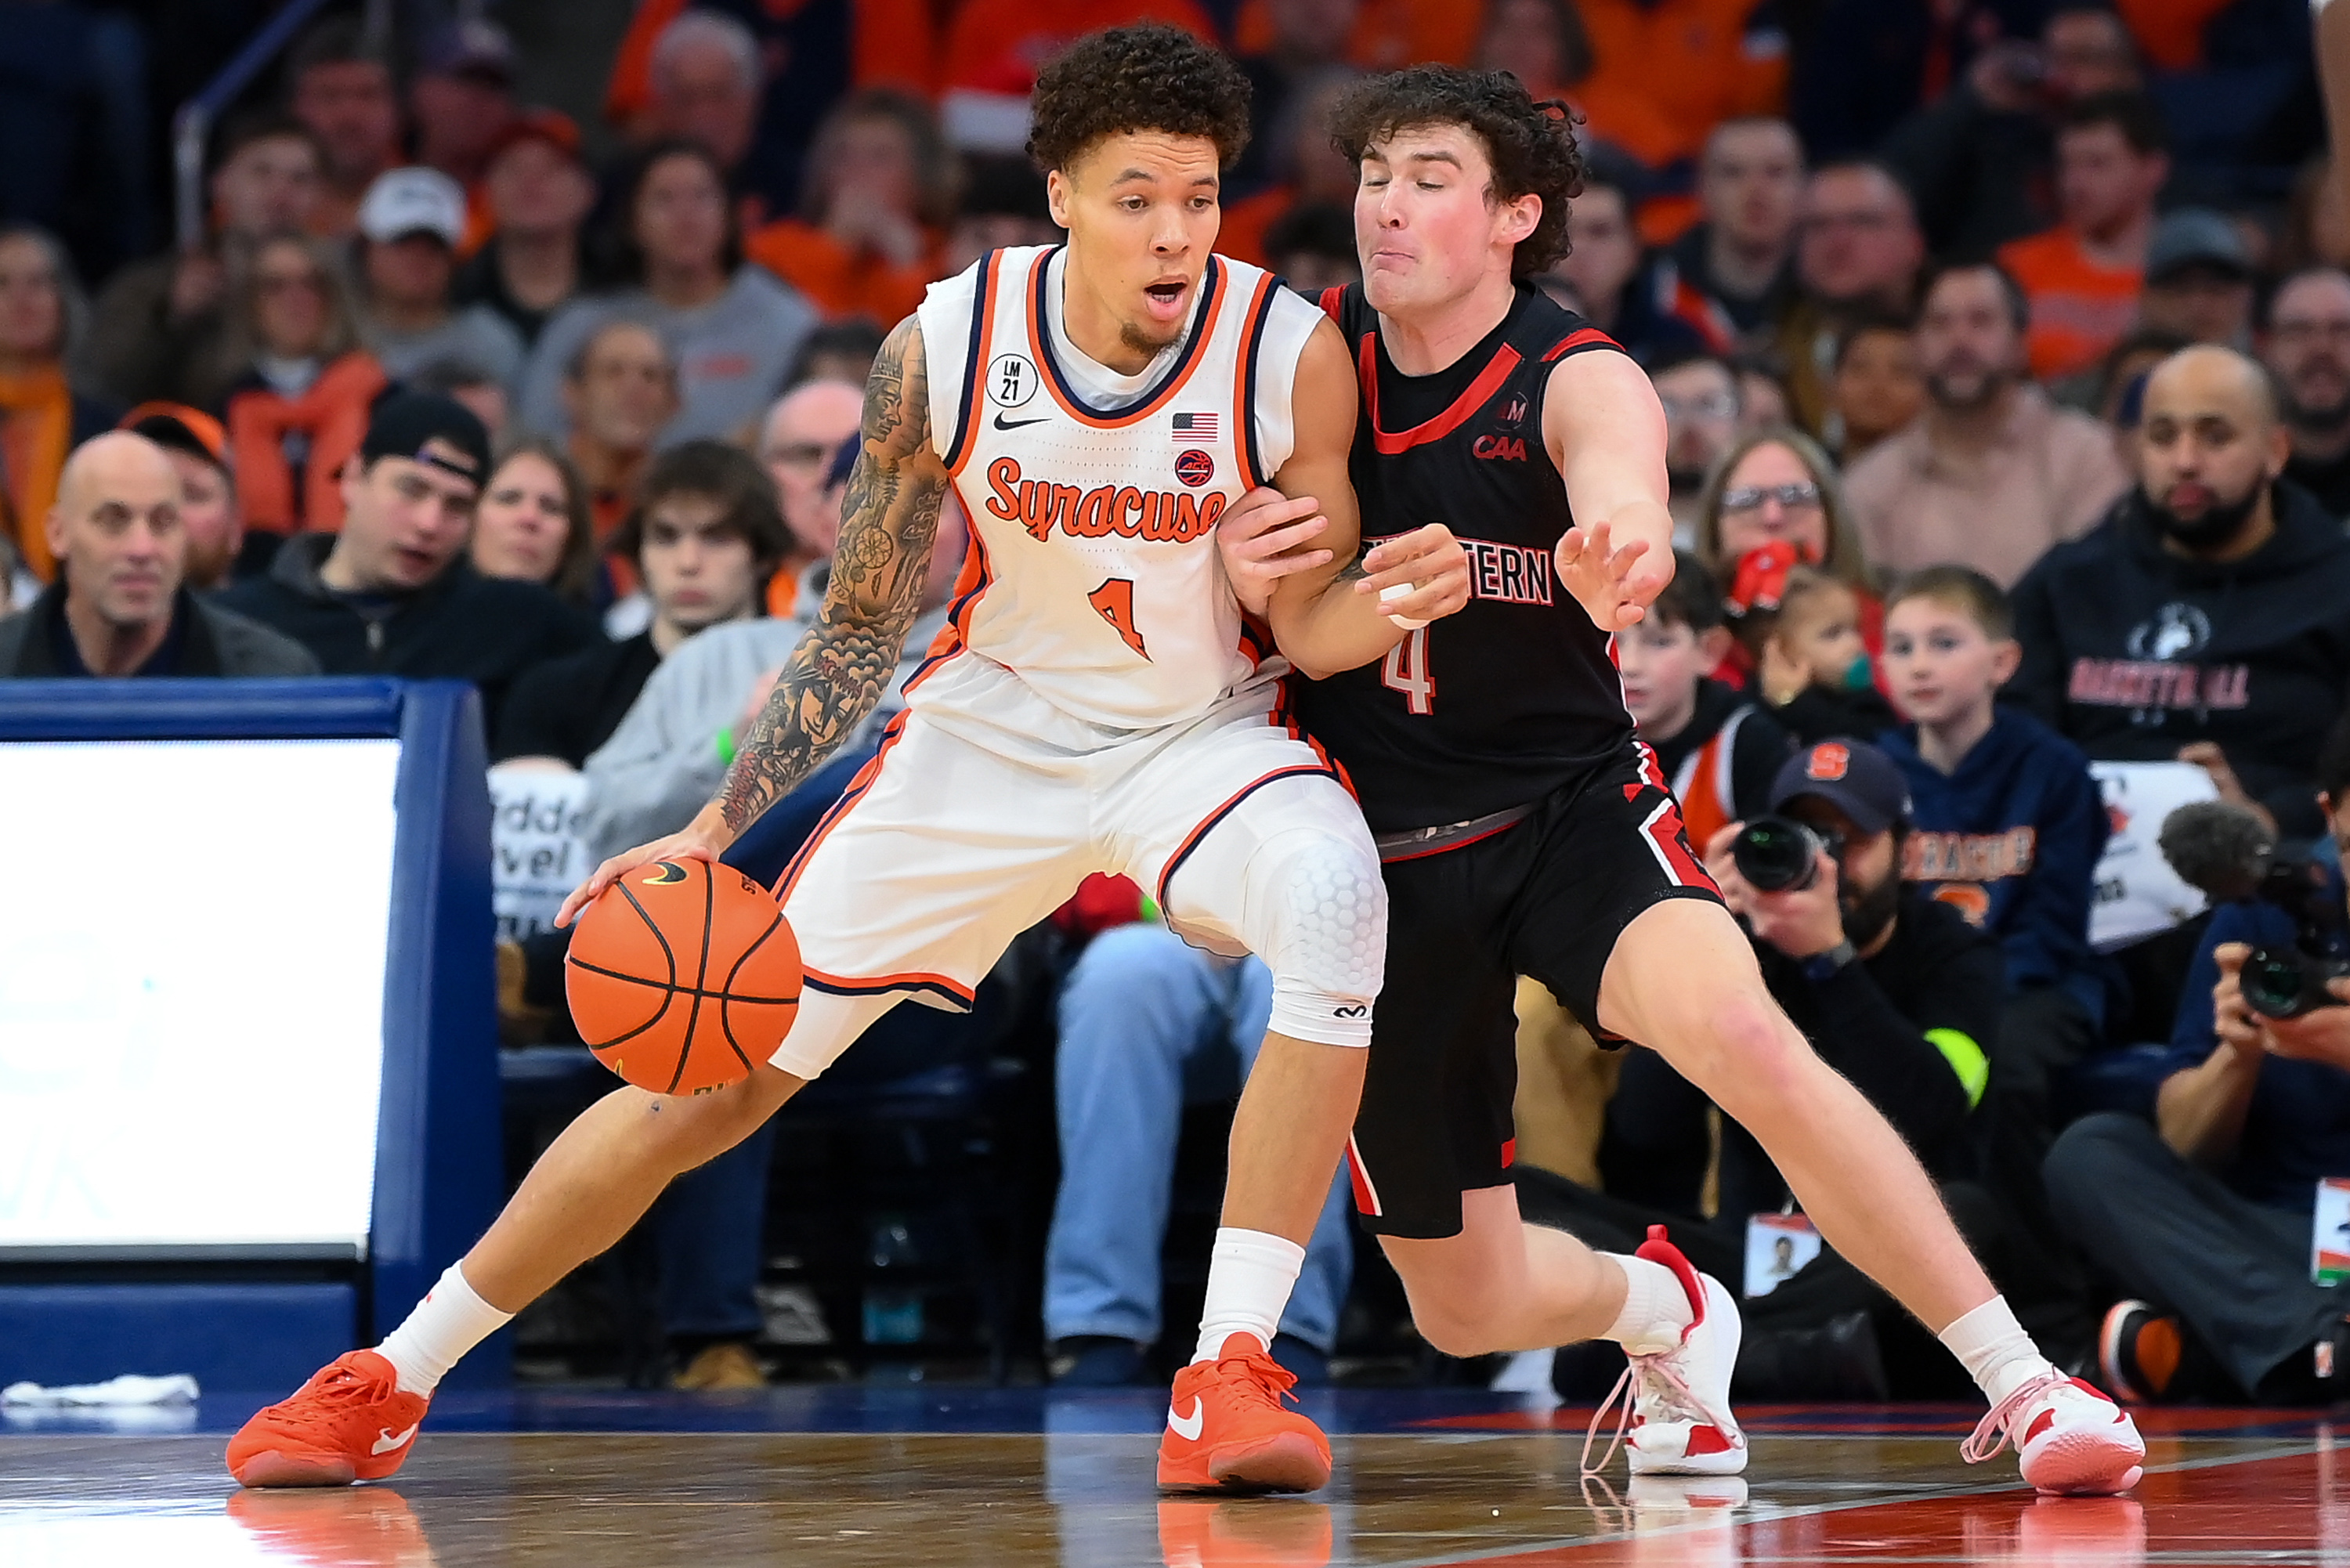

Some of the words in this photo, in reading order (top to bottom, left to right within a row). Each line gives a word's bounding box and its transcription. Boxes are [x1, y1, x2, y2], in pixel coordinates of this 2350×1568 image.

[1003, 359, 1021, 378] LM
[1000, 378, 1019, 401] 21
[1473, 435, 1528, 461] CAA
[985, 456, 1227, 543] Syracuse
[1381, 624, 1437, 715] 4
